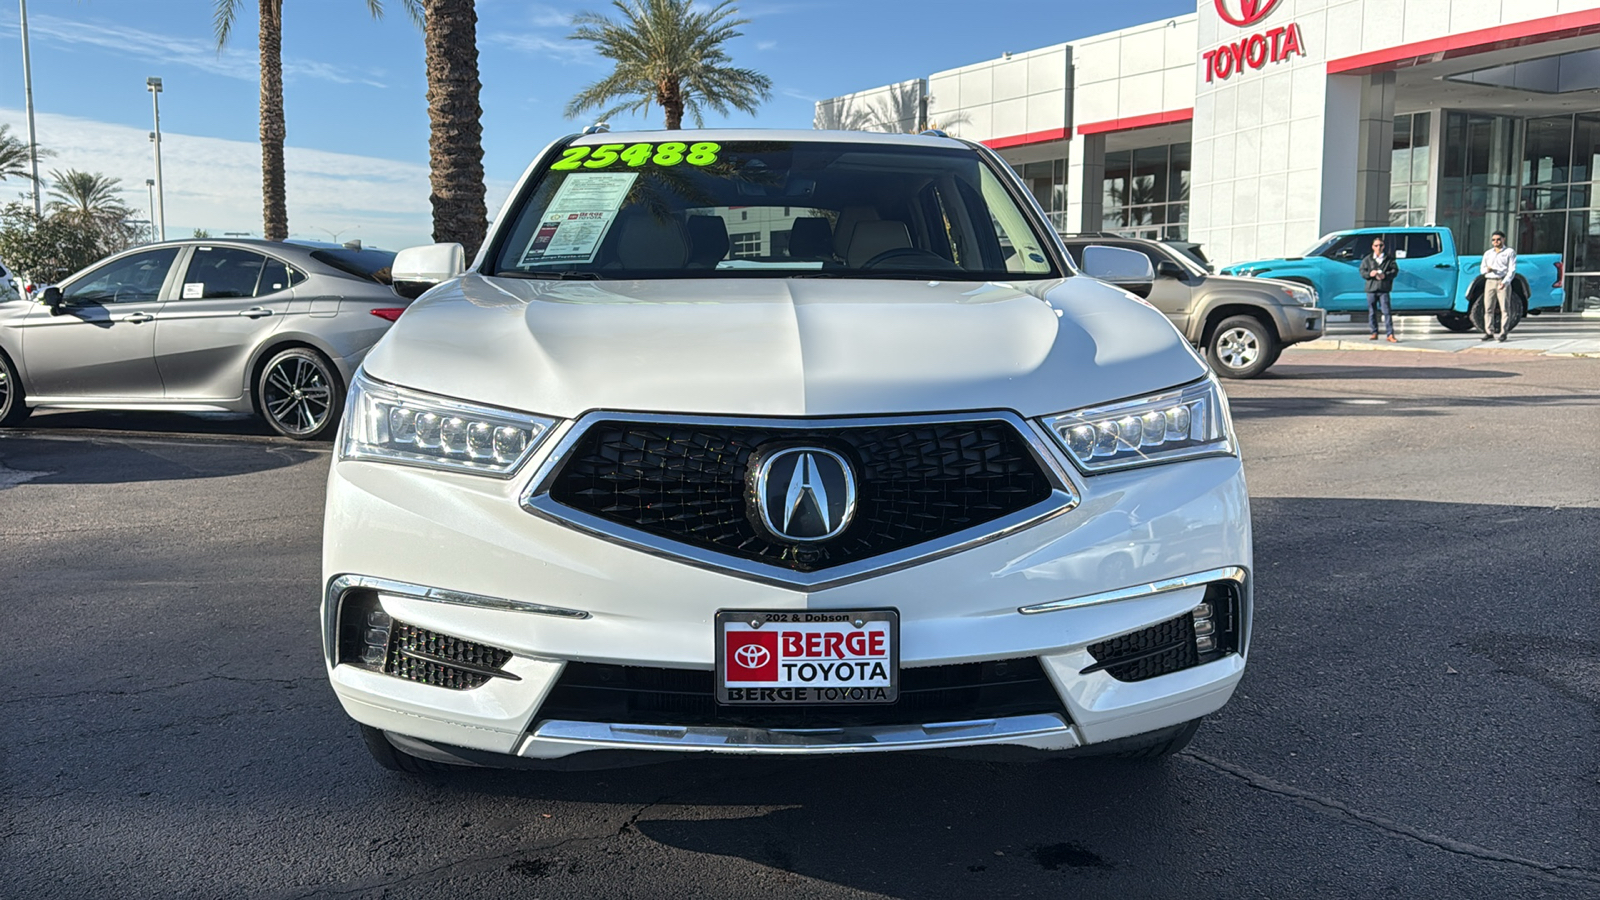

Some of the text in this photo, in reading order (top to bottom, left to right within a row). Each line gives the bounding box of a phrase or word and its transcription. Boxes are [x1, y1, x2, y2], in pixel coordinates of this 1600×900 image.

[1202, 22, 1306, 84] TOYOTA
[550, 141, 720, 170] 25488
[766, 614, 849, 622] 202 & Dobson
[782, 631, 886, 659] BERGE
[782, 662, 887, 682] TOYOTA
[728, 687, 887, 701] BERGE TOYOTA
